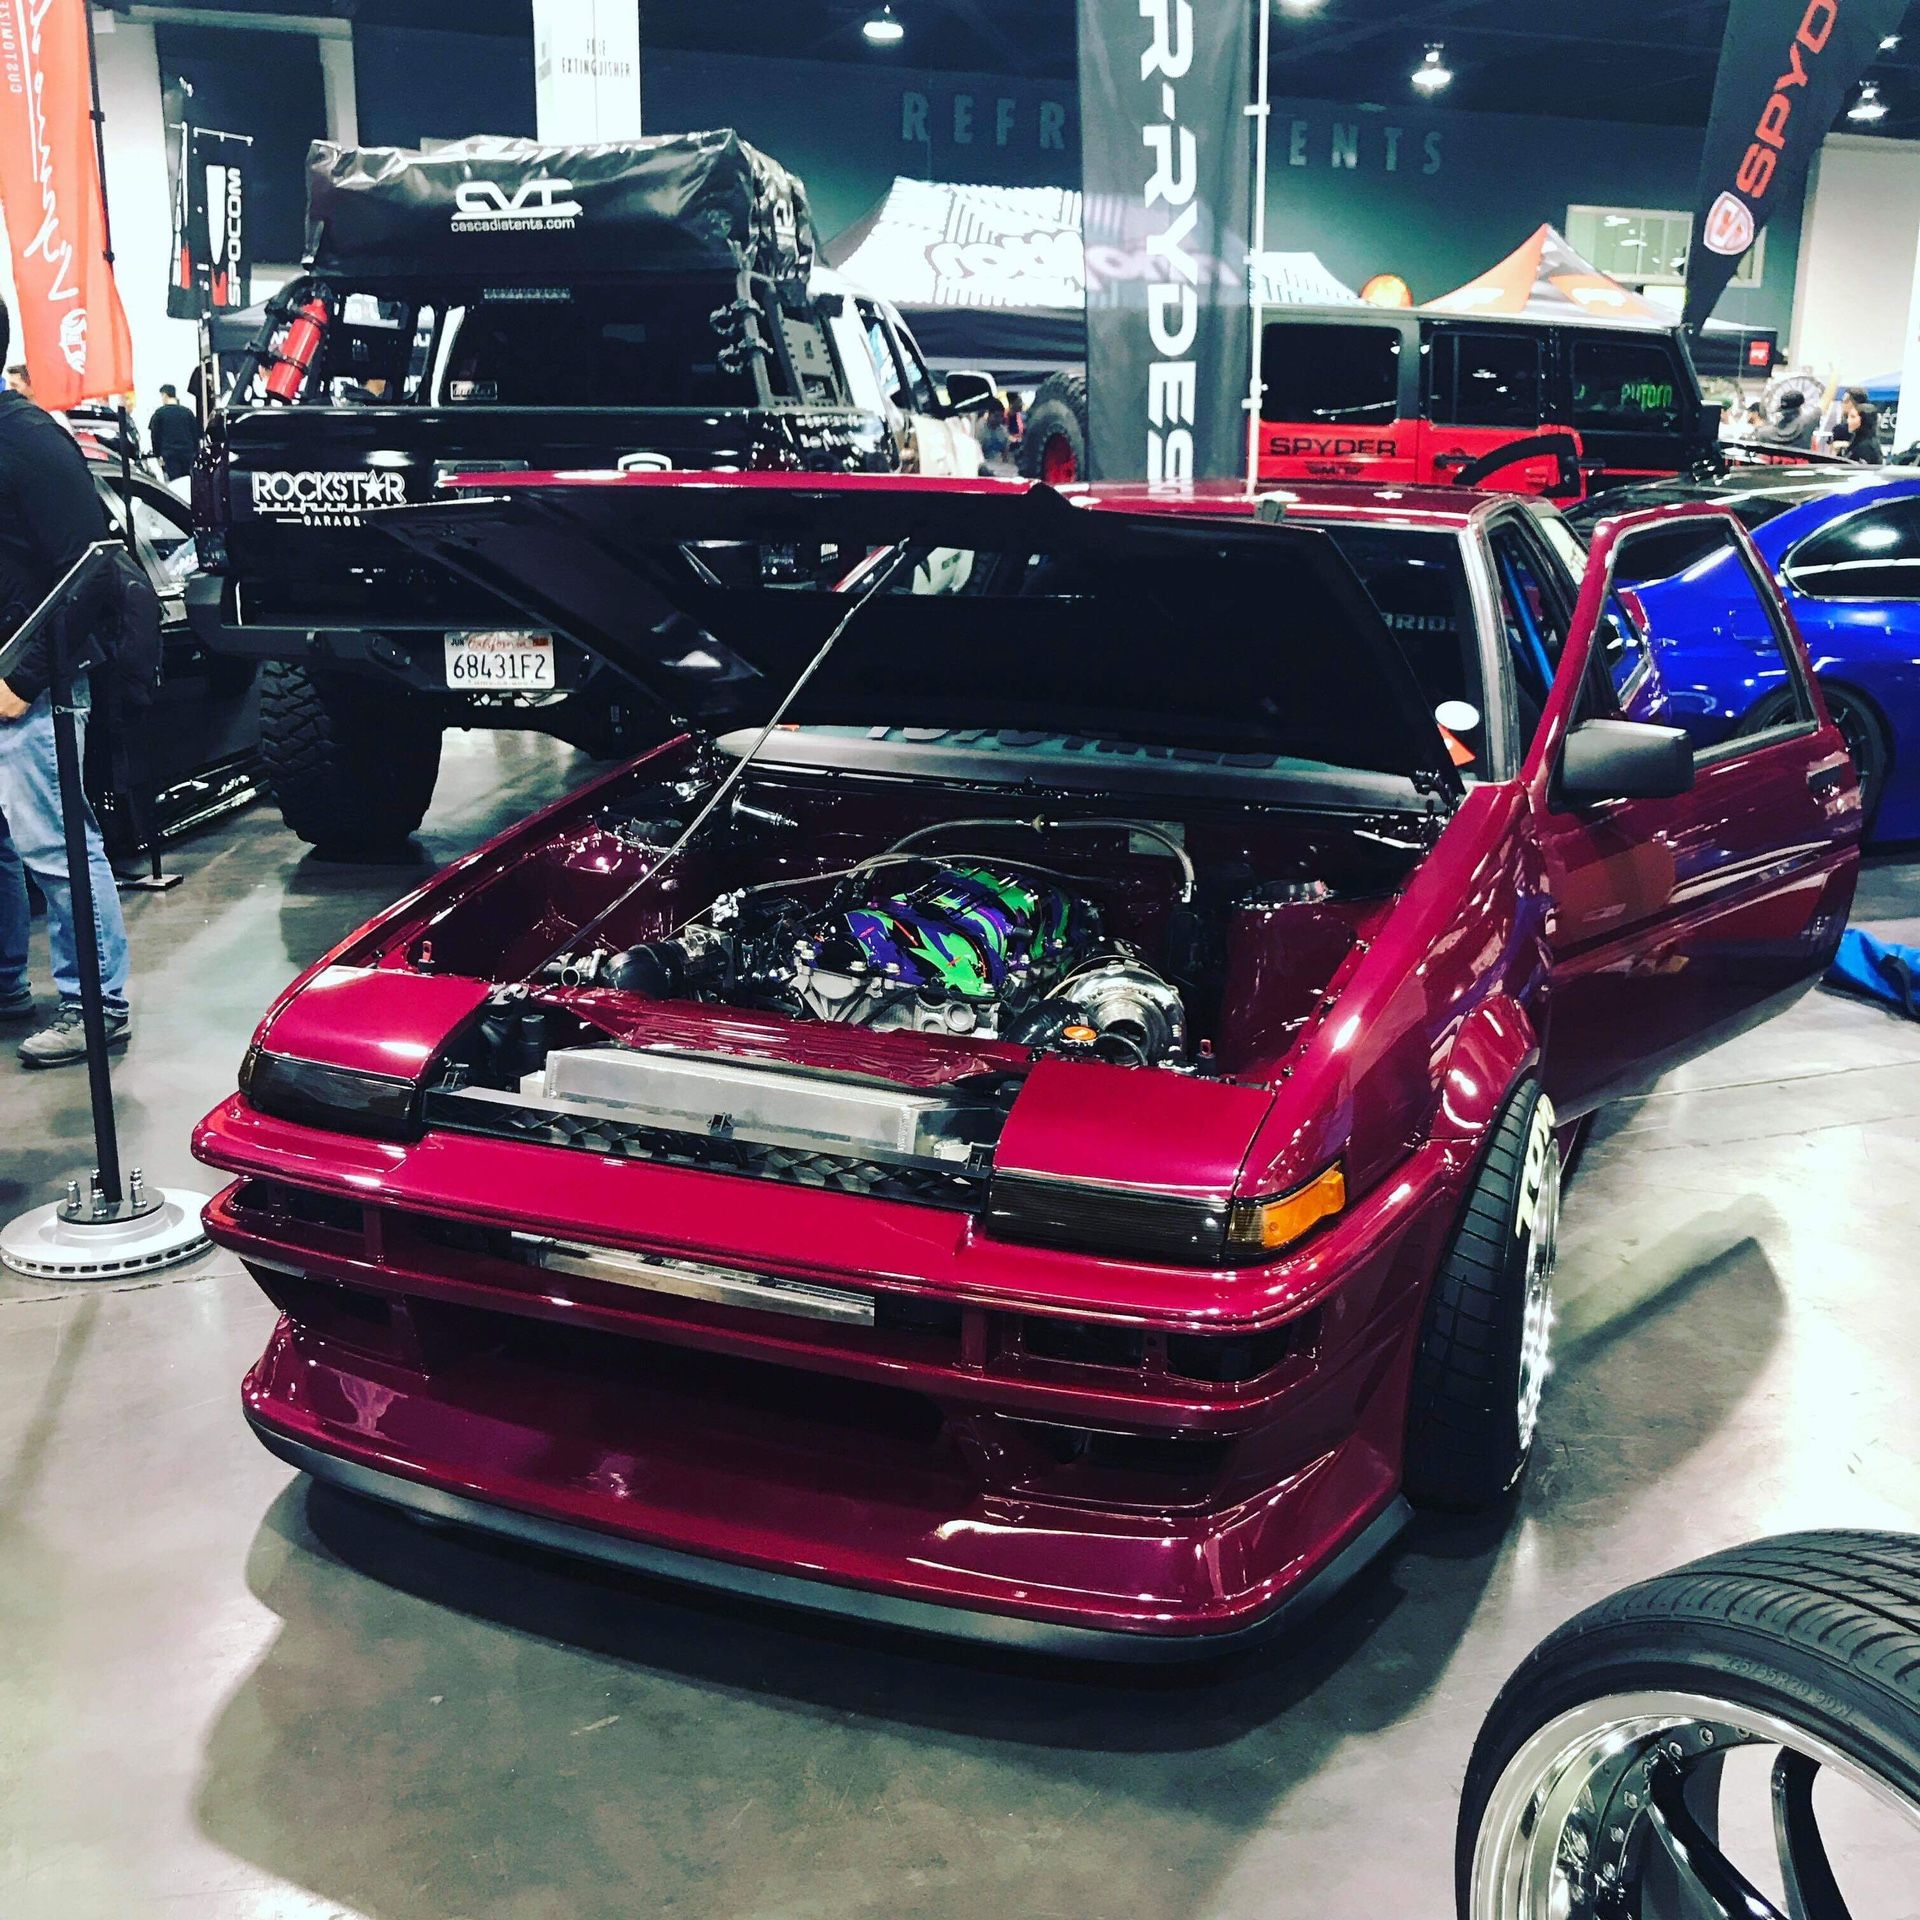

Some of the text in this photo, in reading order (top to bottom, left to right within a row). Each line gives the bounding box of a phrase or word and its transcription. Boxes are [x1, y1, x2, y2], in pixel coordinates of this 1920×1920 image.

[228, 167, 242, 307] SPOCOM
[451, 218, 575, 233] cascadiatents.com
[1270, 437, 1396, 457] SPYDER
[453, 653, 546, 679] 68431F2
